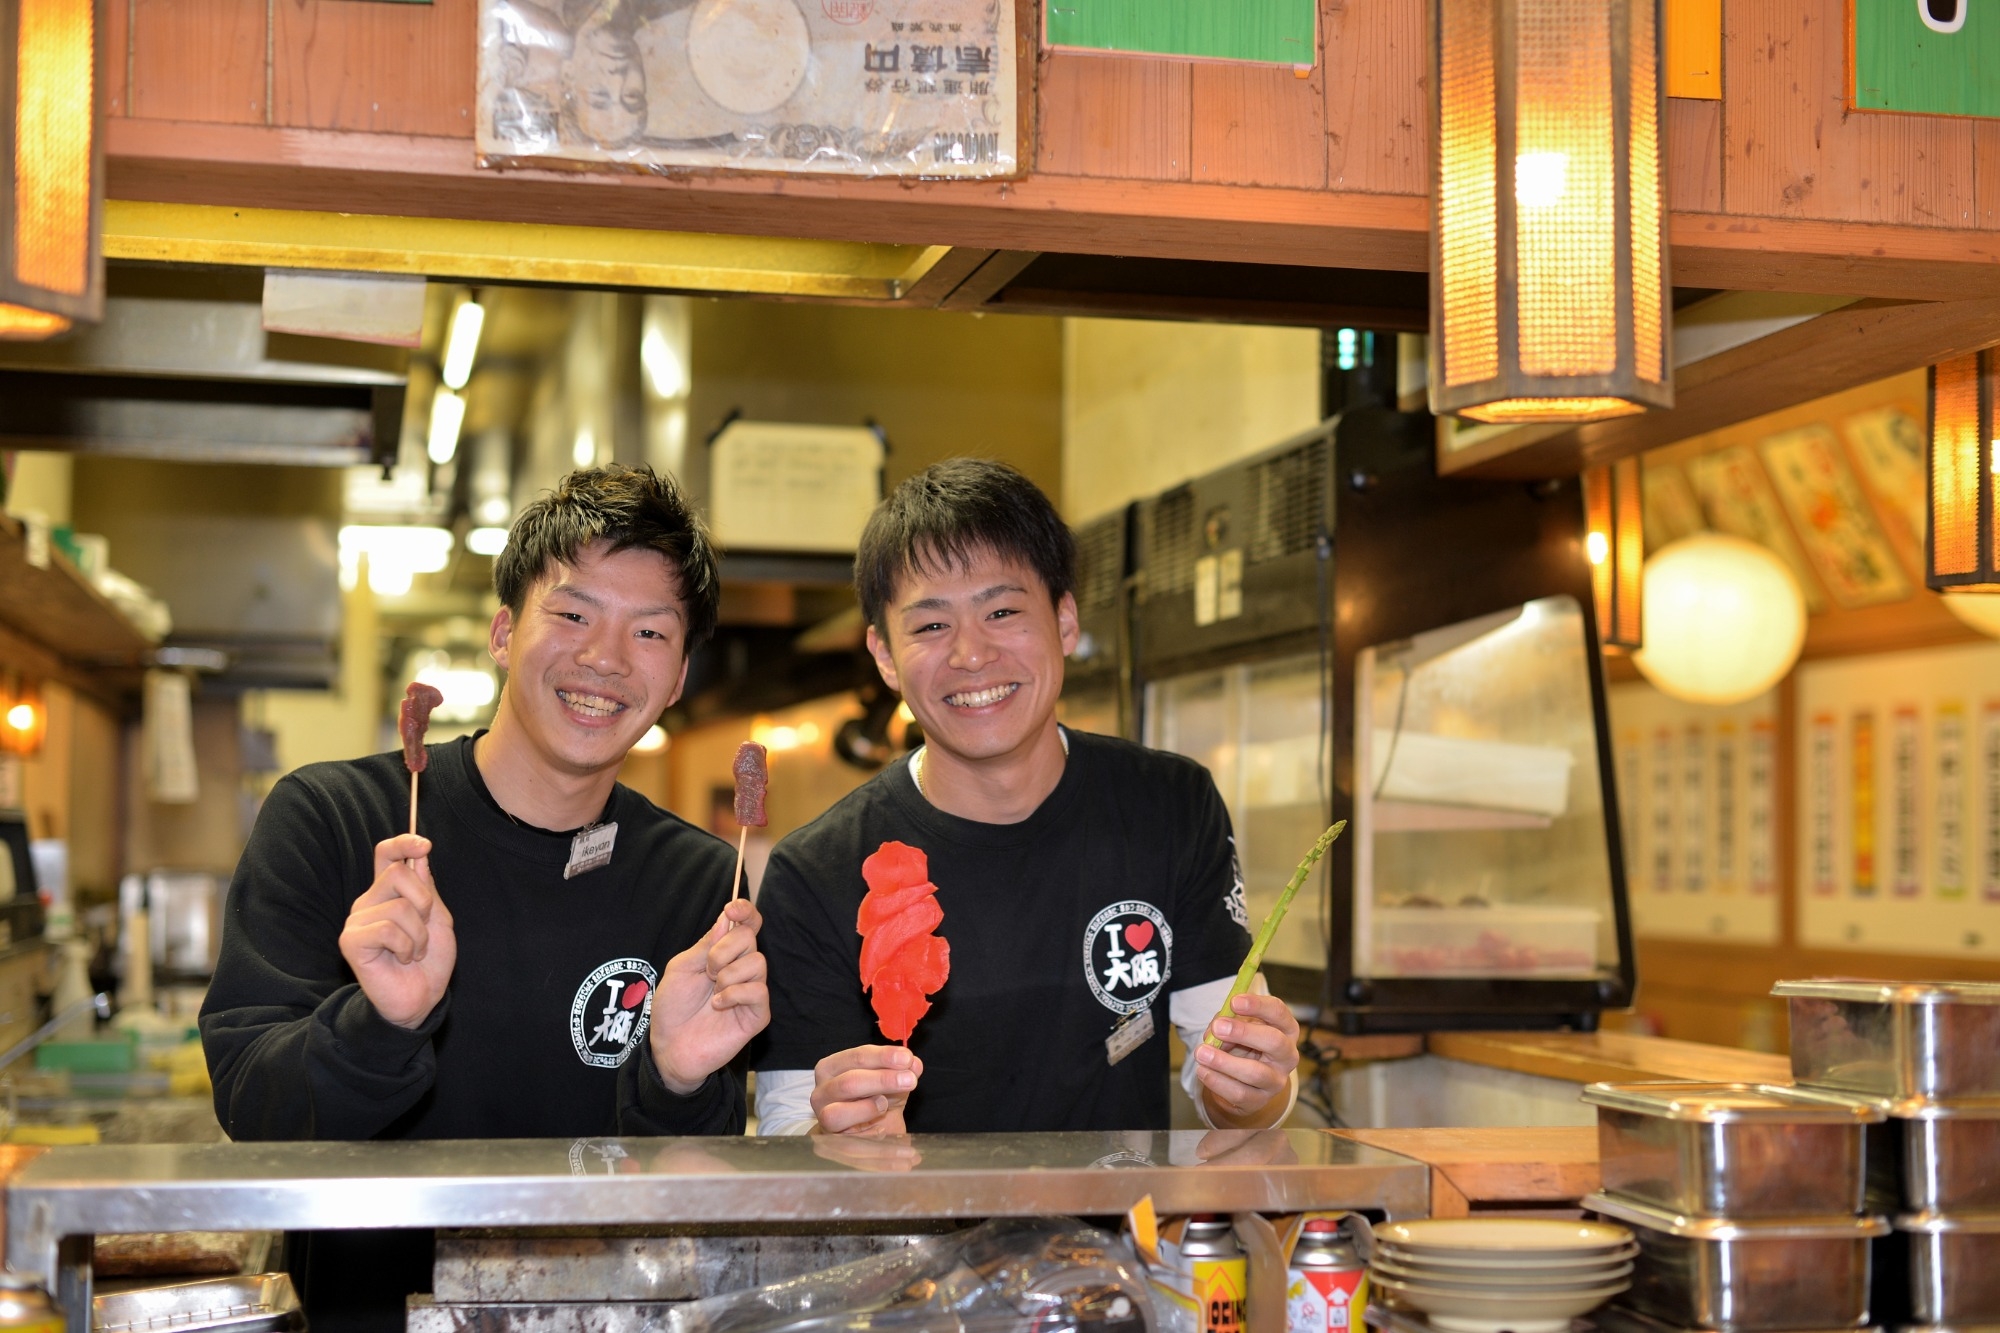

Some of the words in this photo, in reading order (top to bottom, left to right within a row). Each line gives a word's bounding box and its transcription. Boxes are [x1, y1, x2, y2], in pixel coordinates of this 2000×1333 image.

[1103, 923, 1126, 958] I
[1103, 950, 1162, 992] 大阪
[602, 979, 625, 1015] I
[588, 1009, 636, 1047] 大阪
